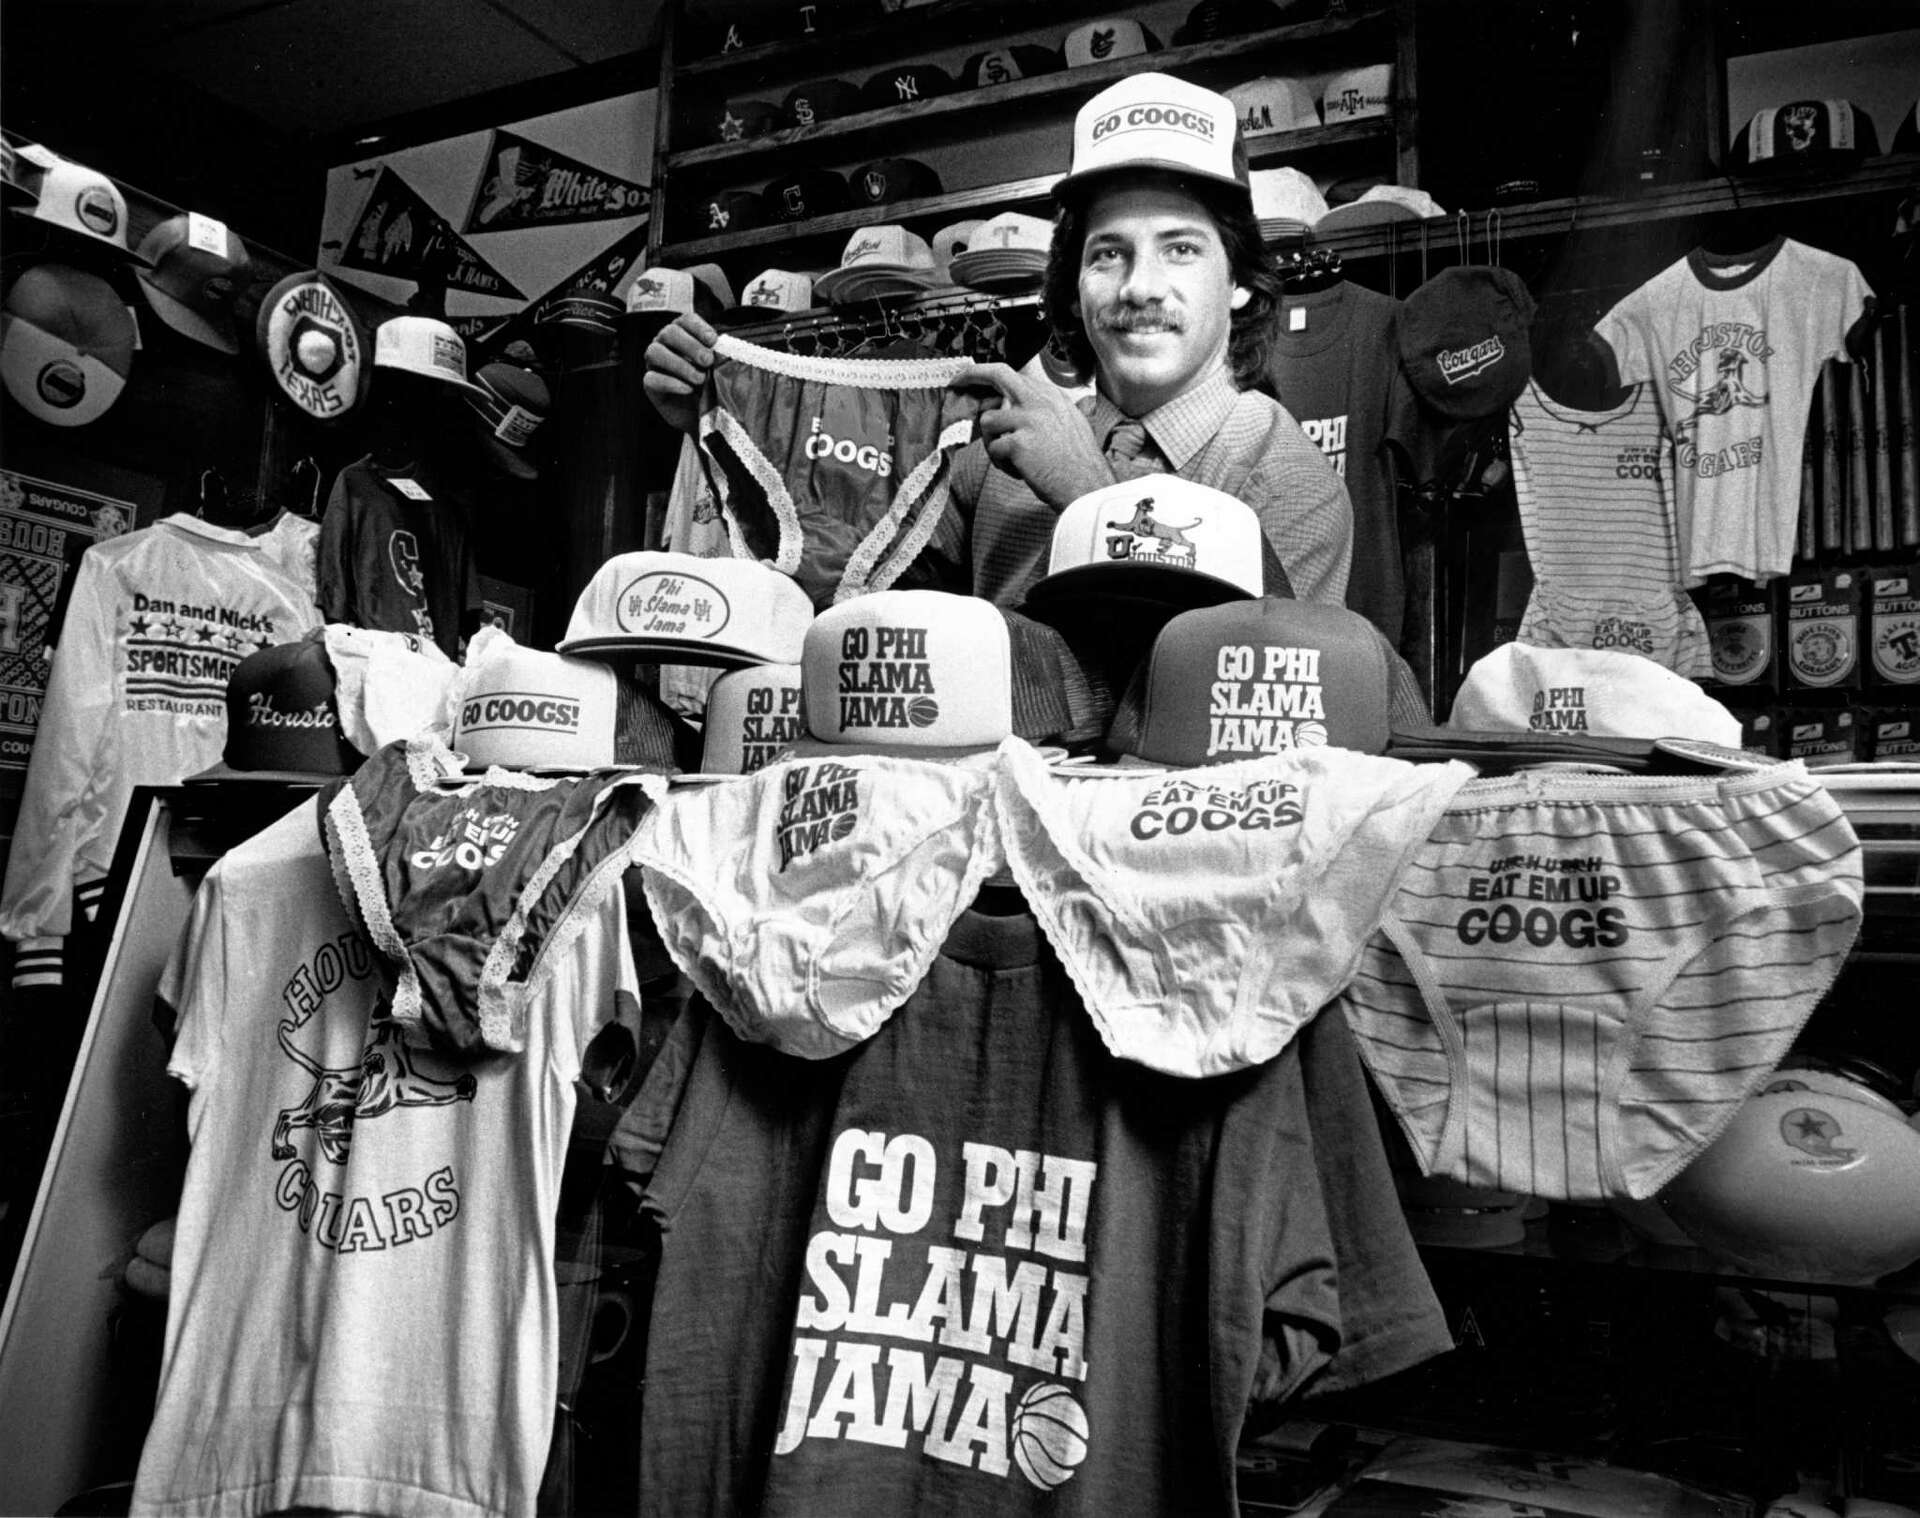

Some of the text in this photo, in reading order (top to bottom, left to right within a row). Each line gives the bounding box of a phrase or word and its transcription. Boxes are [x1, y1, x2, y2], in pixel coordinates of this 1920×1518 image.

[800, 5, 817, 33] T
[895, 75, 919, 100] NY
[1092, 114, 1122, 140] GO
[1127, 107, 1214, 139] COOGS!
[540, 167, 608, 209] White
[1437, 335, 1505, 373] Cougars
[280, 359, 343, 412] TEXAS
[655, 577, 685, 596] Phi
[133, 592, 275, 634] Dan and Nick's
[643, 595, 691, 616] Slama
[1789, 604, 1850, 618] BUTTONS
[643, 613, 686, 634] Jama
[841, 626, 929, 661] GO PHI
[838, 662, 935, 695] SLAMA
[1216, 645, 1321, 684] GO PHI
[126, 699, 223, 719] RESTAURANT
[461, 700, 580, 728] GO COOGS!
[747, 687, 774, 716] GO
[839, 696, 910, 734] JAMA
[1209, 681, 1326, 720] SLAMA
[1549, 688, 1585, 708] PHI
[1206, 717, 1299, 757] JAMA
[1141, 788, 1196, 808] EAT
[1257, 783, 1299, 806] UP
[1130, 800, 1304, 842] COOGS
[1467, 873, 1622, 903] EAT EM UP
[1457, 903, 1630, 949] COOGS
[825, 1127, 1099, 1263] GO PHI
[795, 1230, 1090, 1383] SLAMA
[773, 1336, 1015, 1478] JAMA
